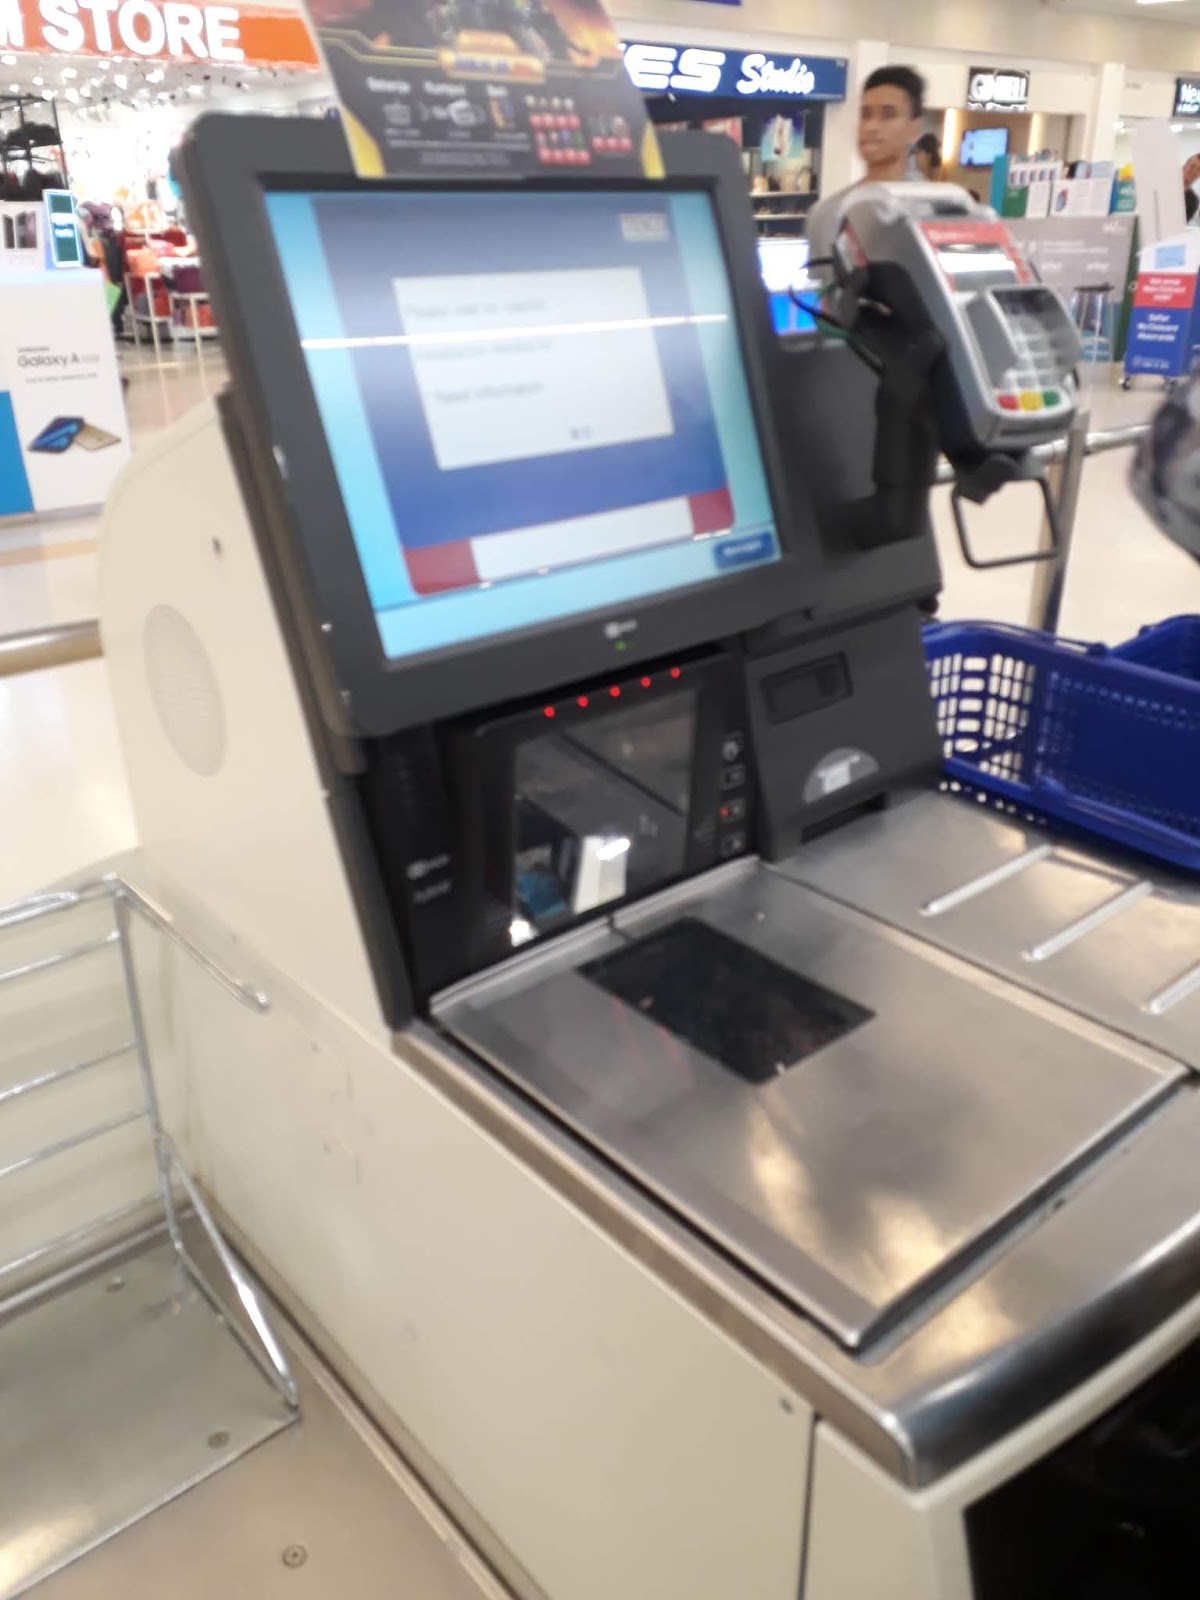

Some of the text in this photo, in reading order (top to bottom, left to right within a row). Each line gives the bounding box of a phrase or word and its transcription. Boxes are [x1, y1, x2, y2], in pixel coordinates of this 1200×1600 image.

[39, 0, 244, 61] STORE
[736, 53, 815, 95] Studio
[17, 355, 68, 367] Galaxy
